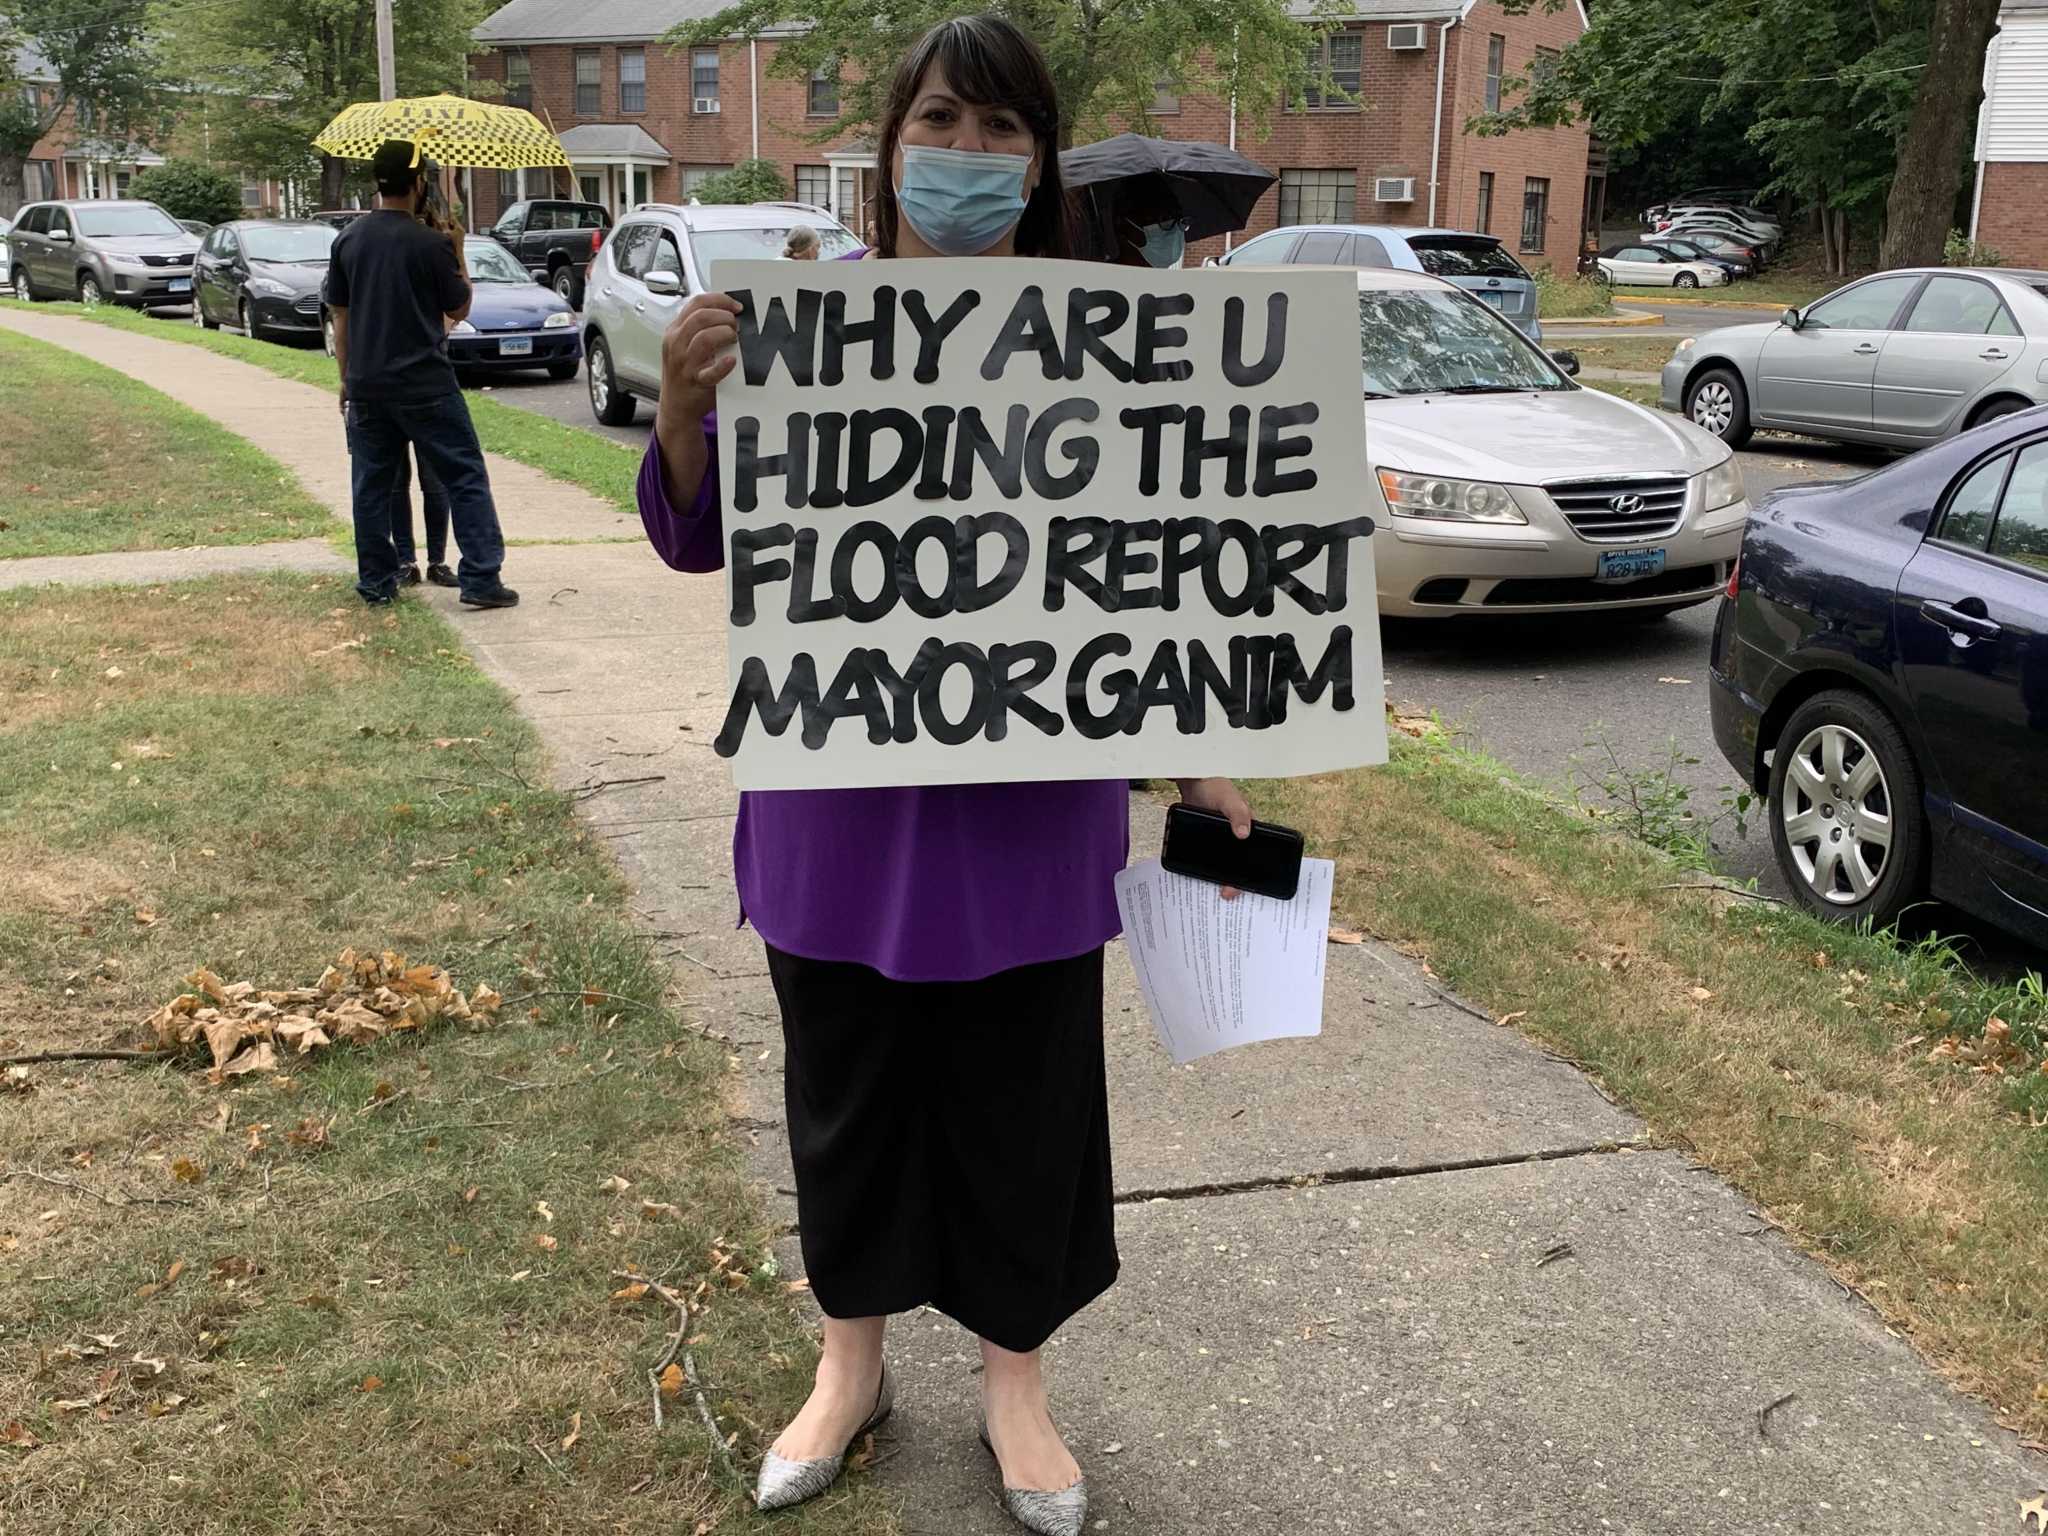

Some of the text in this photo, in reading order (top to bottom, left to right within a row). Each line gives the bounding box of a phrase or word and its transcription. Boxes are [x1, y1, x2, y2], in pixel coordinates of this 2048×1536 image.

[403, 105, 465, 119] TAXI
[730, 286, 1288, 387] WHY ARE U
[733, 397, 1319, 511] HIDING THE
[730, 512, 1375, 627] FLOOD REPORT
[714, 625, 1354, 757] MAYOR GANIM
